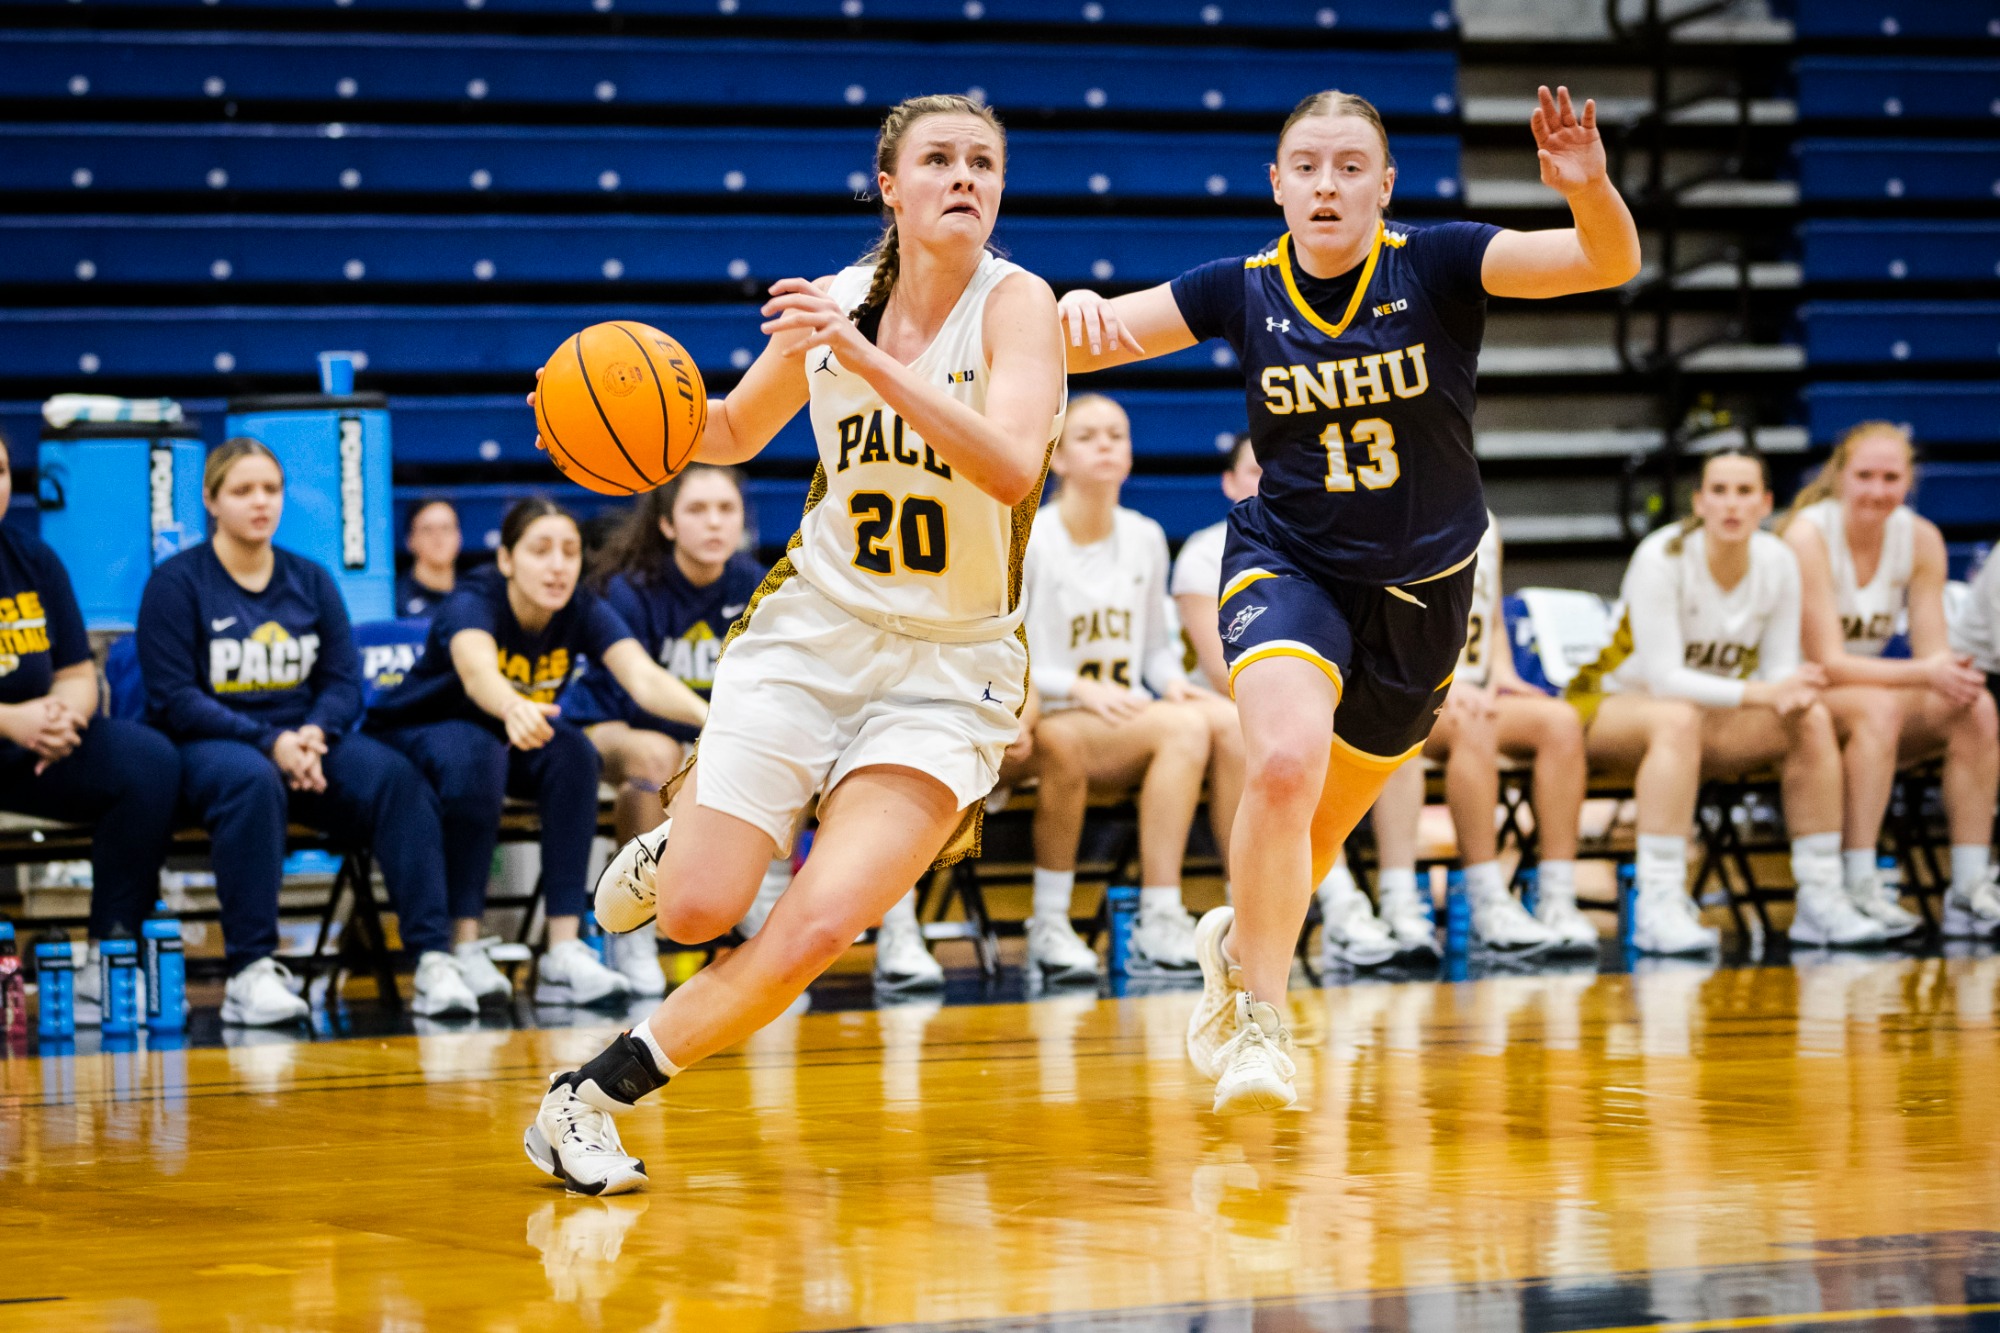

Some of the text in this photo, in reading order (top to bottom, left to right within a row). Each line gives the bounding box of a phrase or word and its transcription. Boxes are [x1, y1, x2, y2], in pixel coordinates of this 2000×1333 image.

[1372, 298, 1409, 318] NE10
[654, 338, 694, 402] EVO
[1261, 343, 1430, 415] SNHU
[1318, 417, 1401, 492] 13
[847, 489, 950, 577] 20
